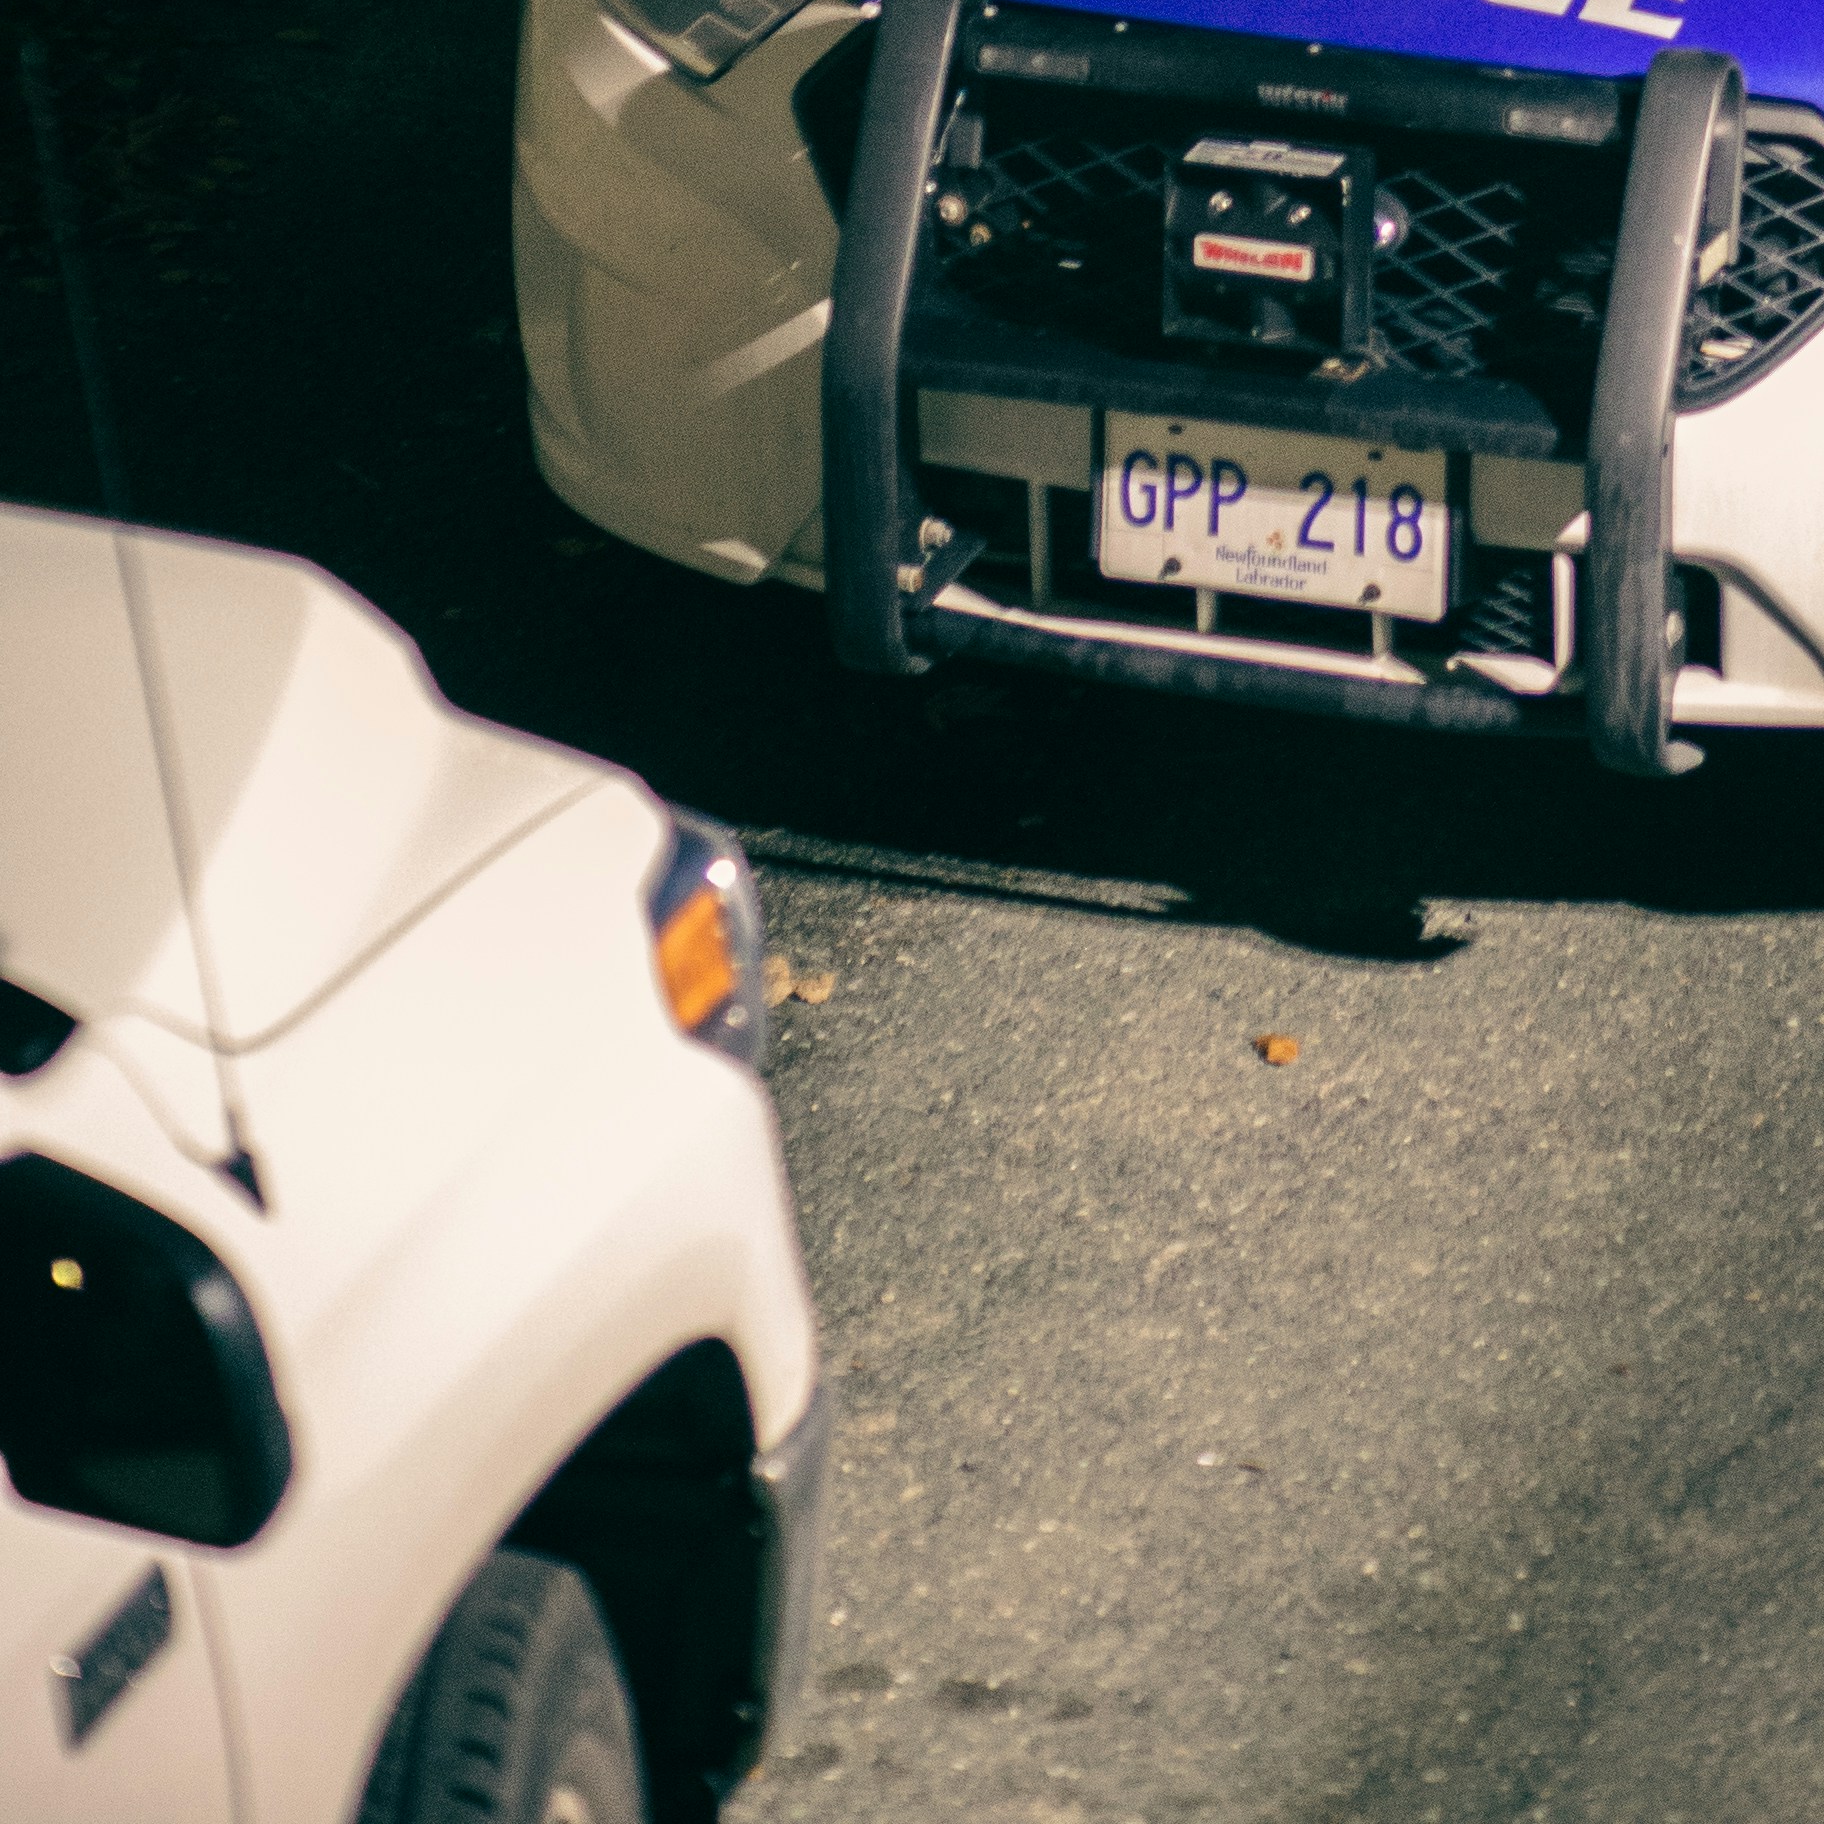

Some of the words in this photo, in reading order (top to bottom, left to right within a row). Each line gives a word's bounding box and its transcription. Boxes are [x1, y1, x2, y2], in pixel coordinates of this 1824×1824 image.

[1120, 449, 1248, 537] GPP
[1296, 470, 1424, 563] 218
[1215, 544, 1327, 575] Newfoundland
[1236, 567, 1306, 591] Labrador
